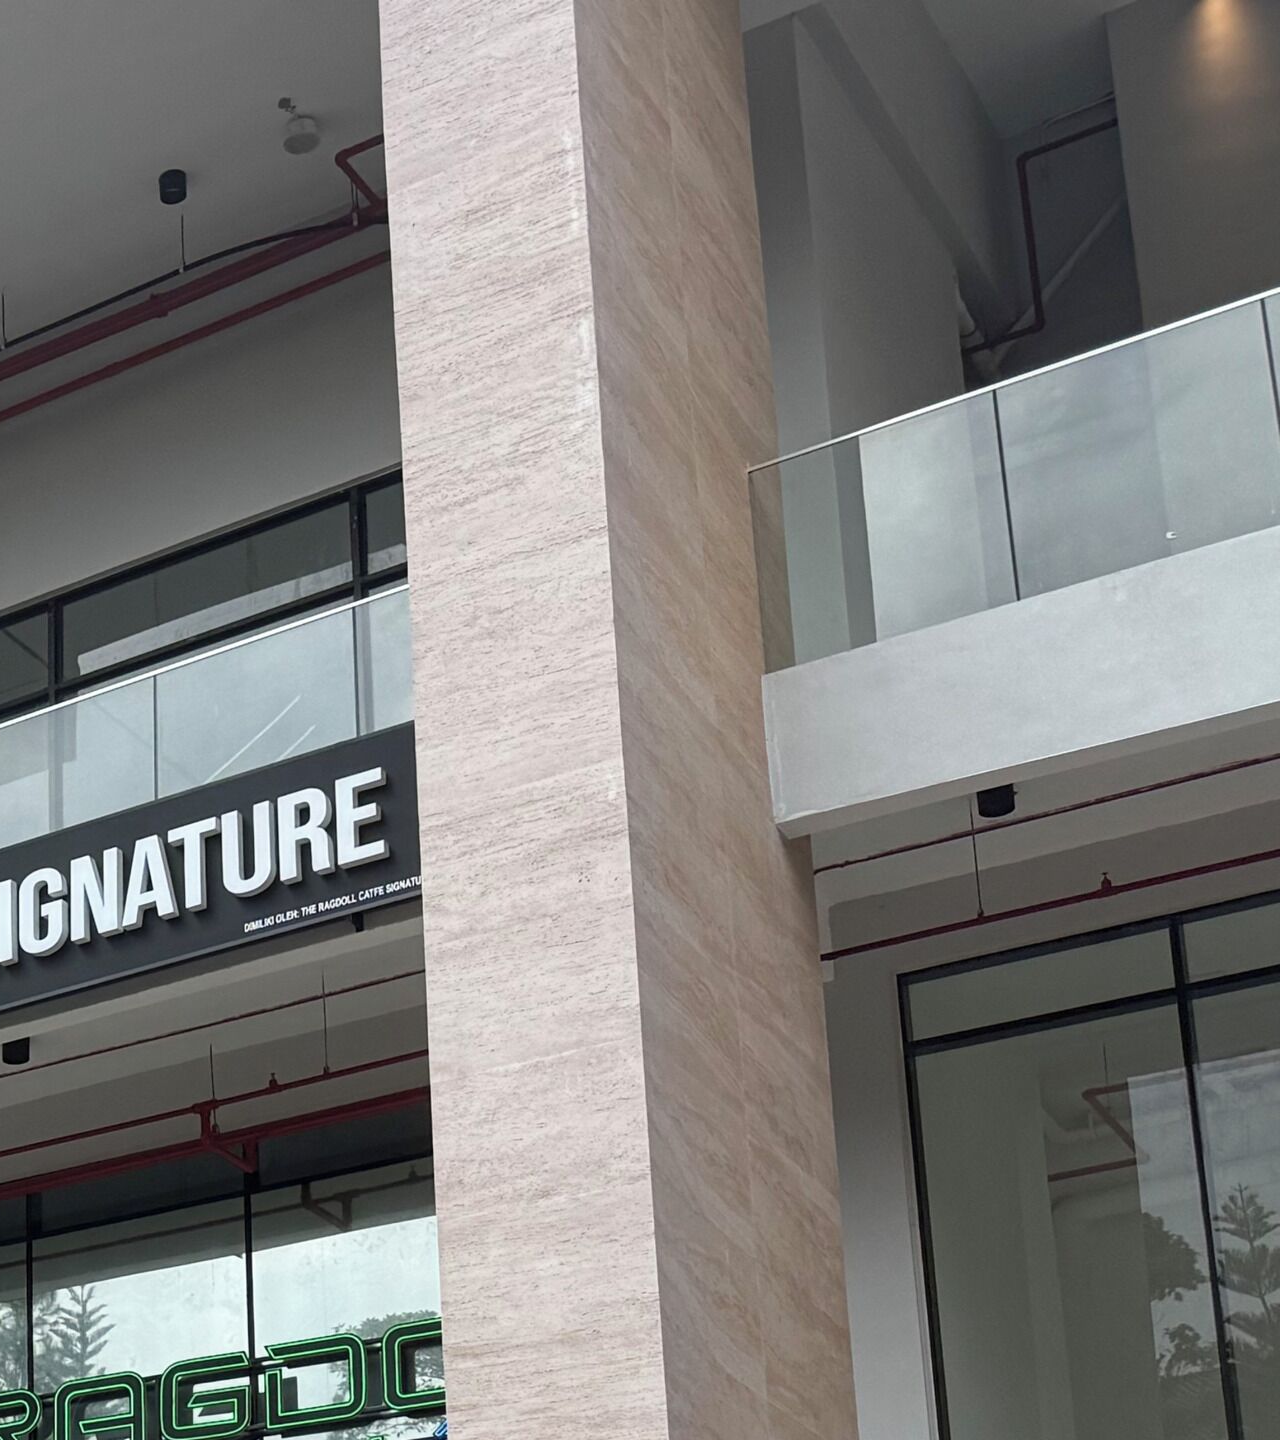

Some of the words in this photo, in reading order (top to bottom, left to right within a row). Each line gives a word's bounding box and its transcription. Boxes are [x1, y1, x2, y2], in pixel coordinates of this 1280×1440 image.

[301, 904, 316, 918] THE
[317, 893, 357, 914] RAGDOLL
[358, 885, 384, 902] CATFE
[385, 875, 422, 894] SIGNATU
